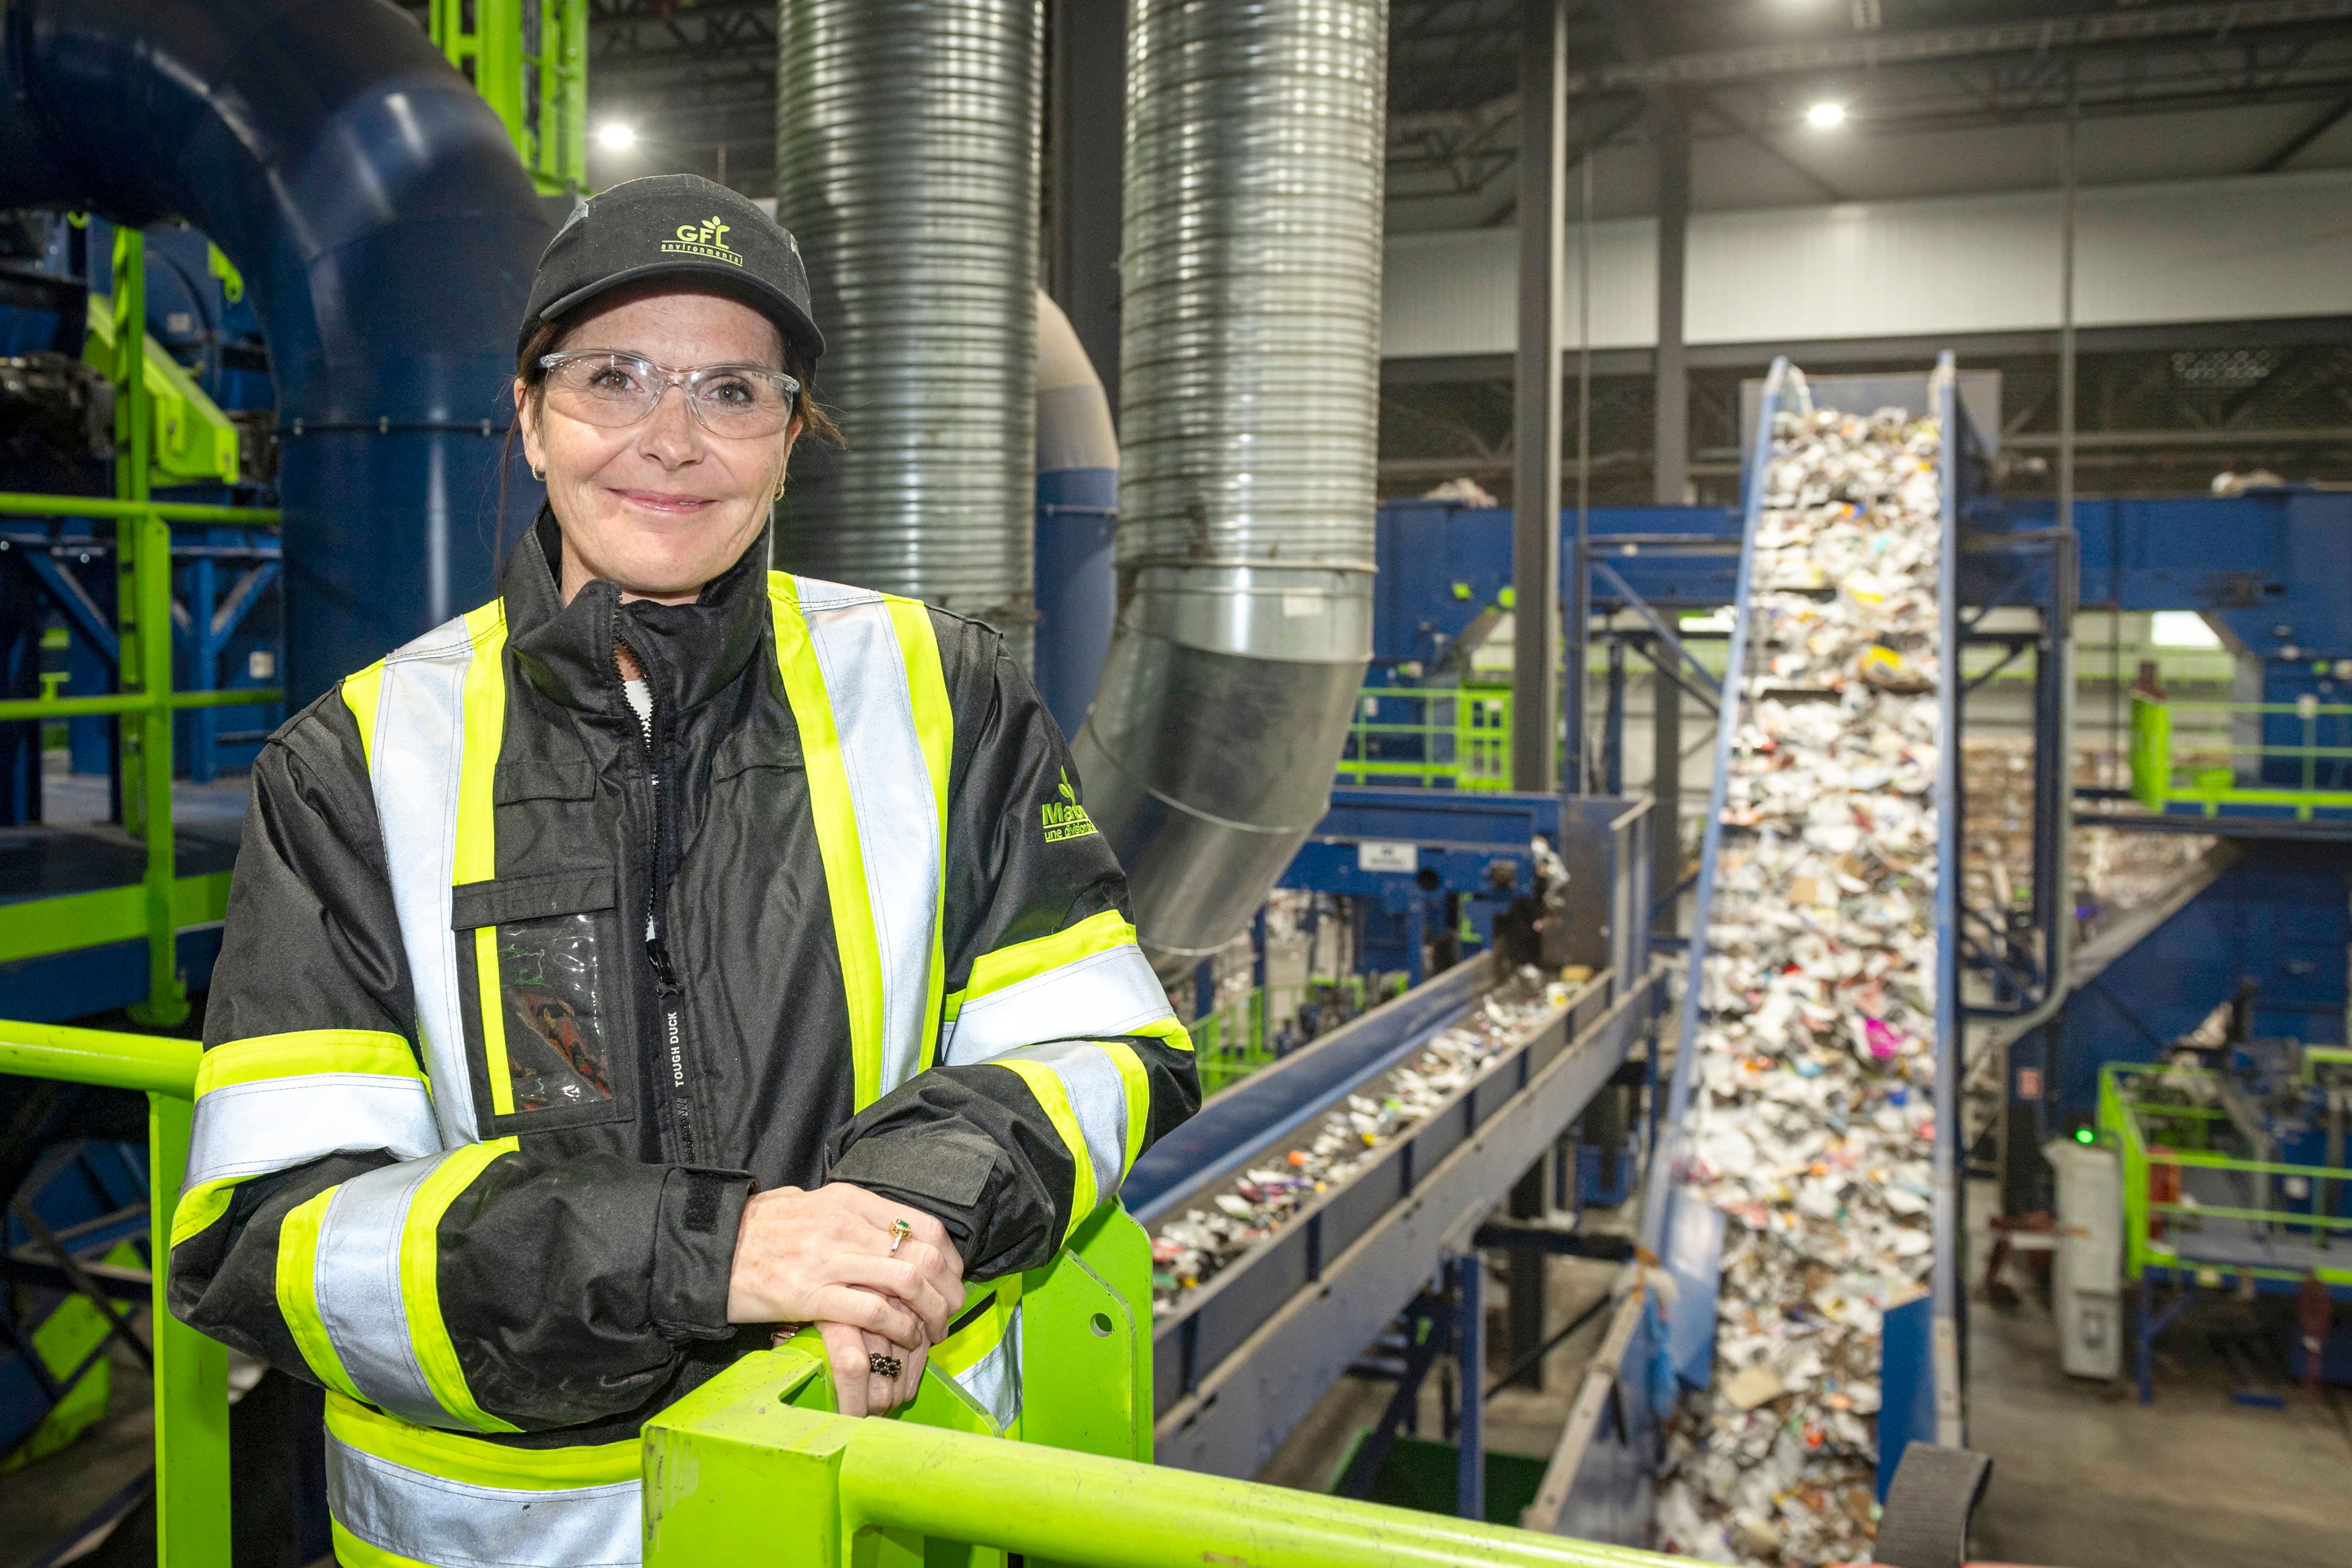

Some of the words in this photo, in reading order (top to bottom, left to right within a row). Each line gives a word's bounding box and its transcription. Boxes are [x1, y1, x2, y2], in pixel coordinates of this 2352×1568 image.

[677, 225, 730, 249] GFL
[661, 242, 743, 265] environmental
[1044, 828, 1063, 840] une
[667, 1011, 679, 1044] DUCK
[671, 1046, 684, 1088] TOUGH
